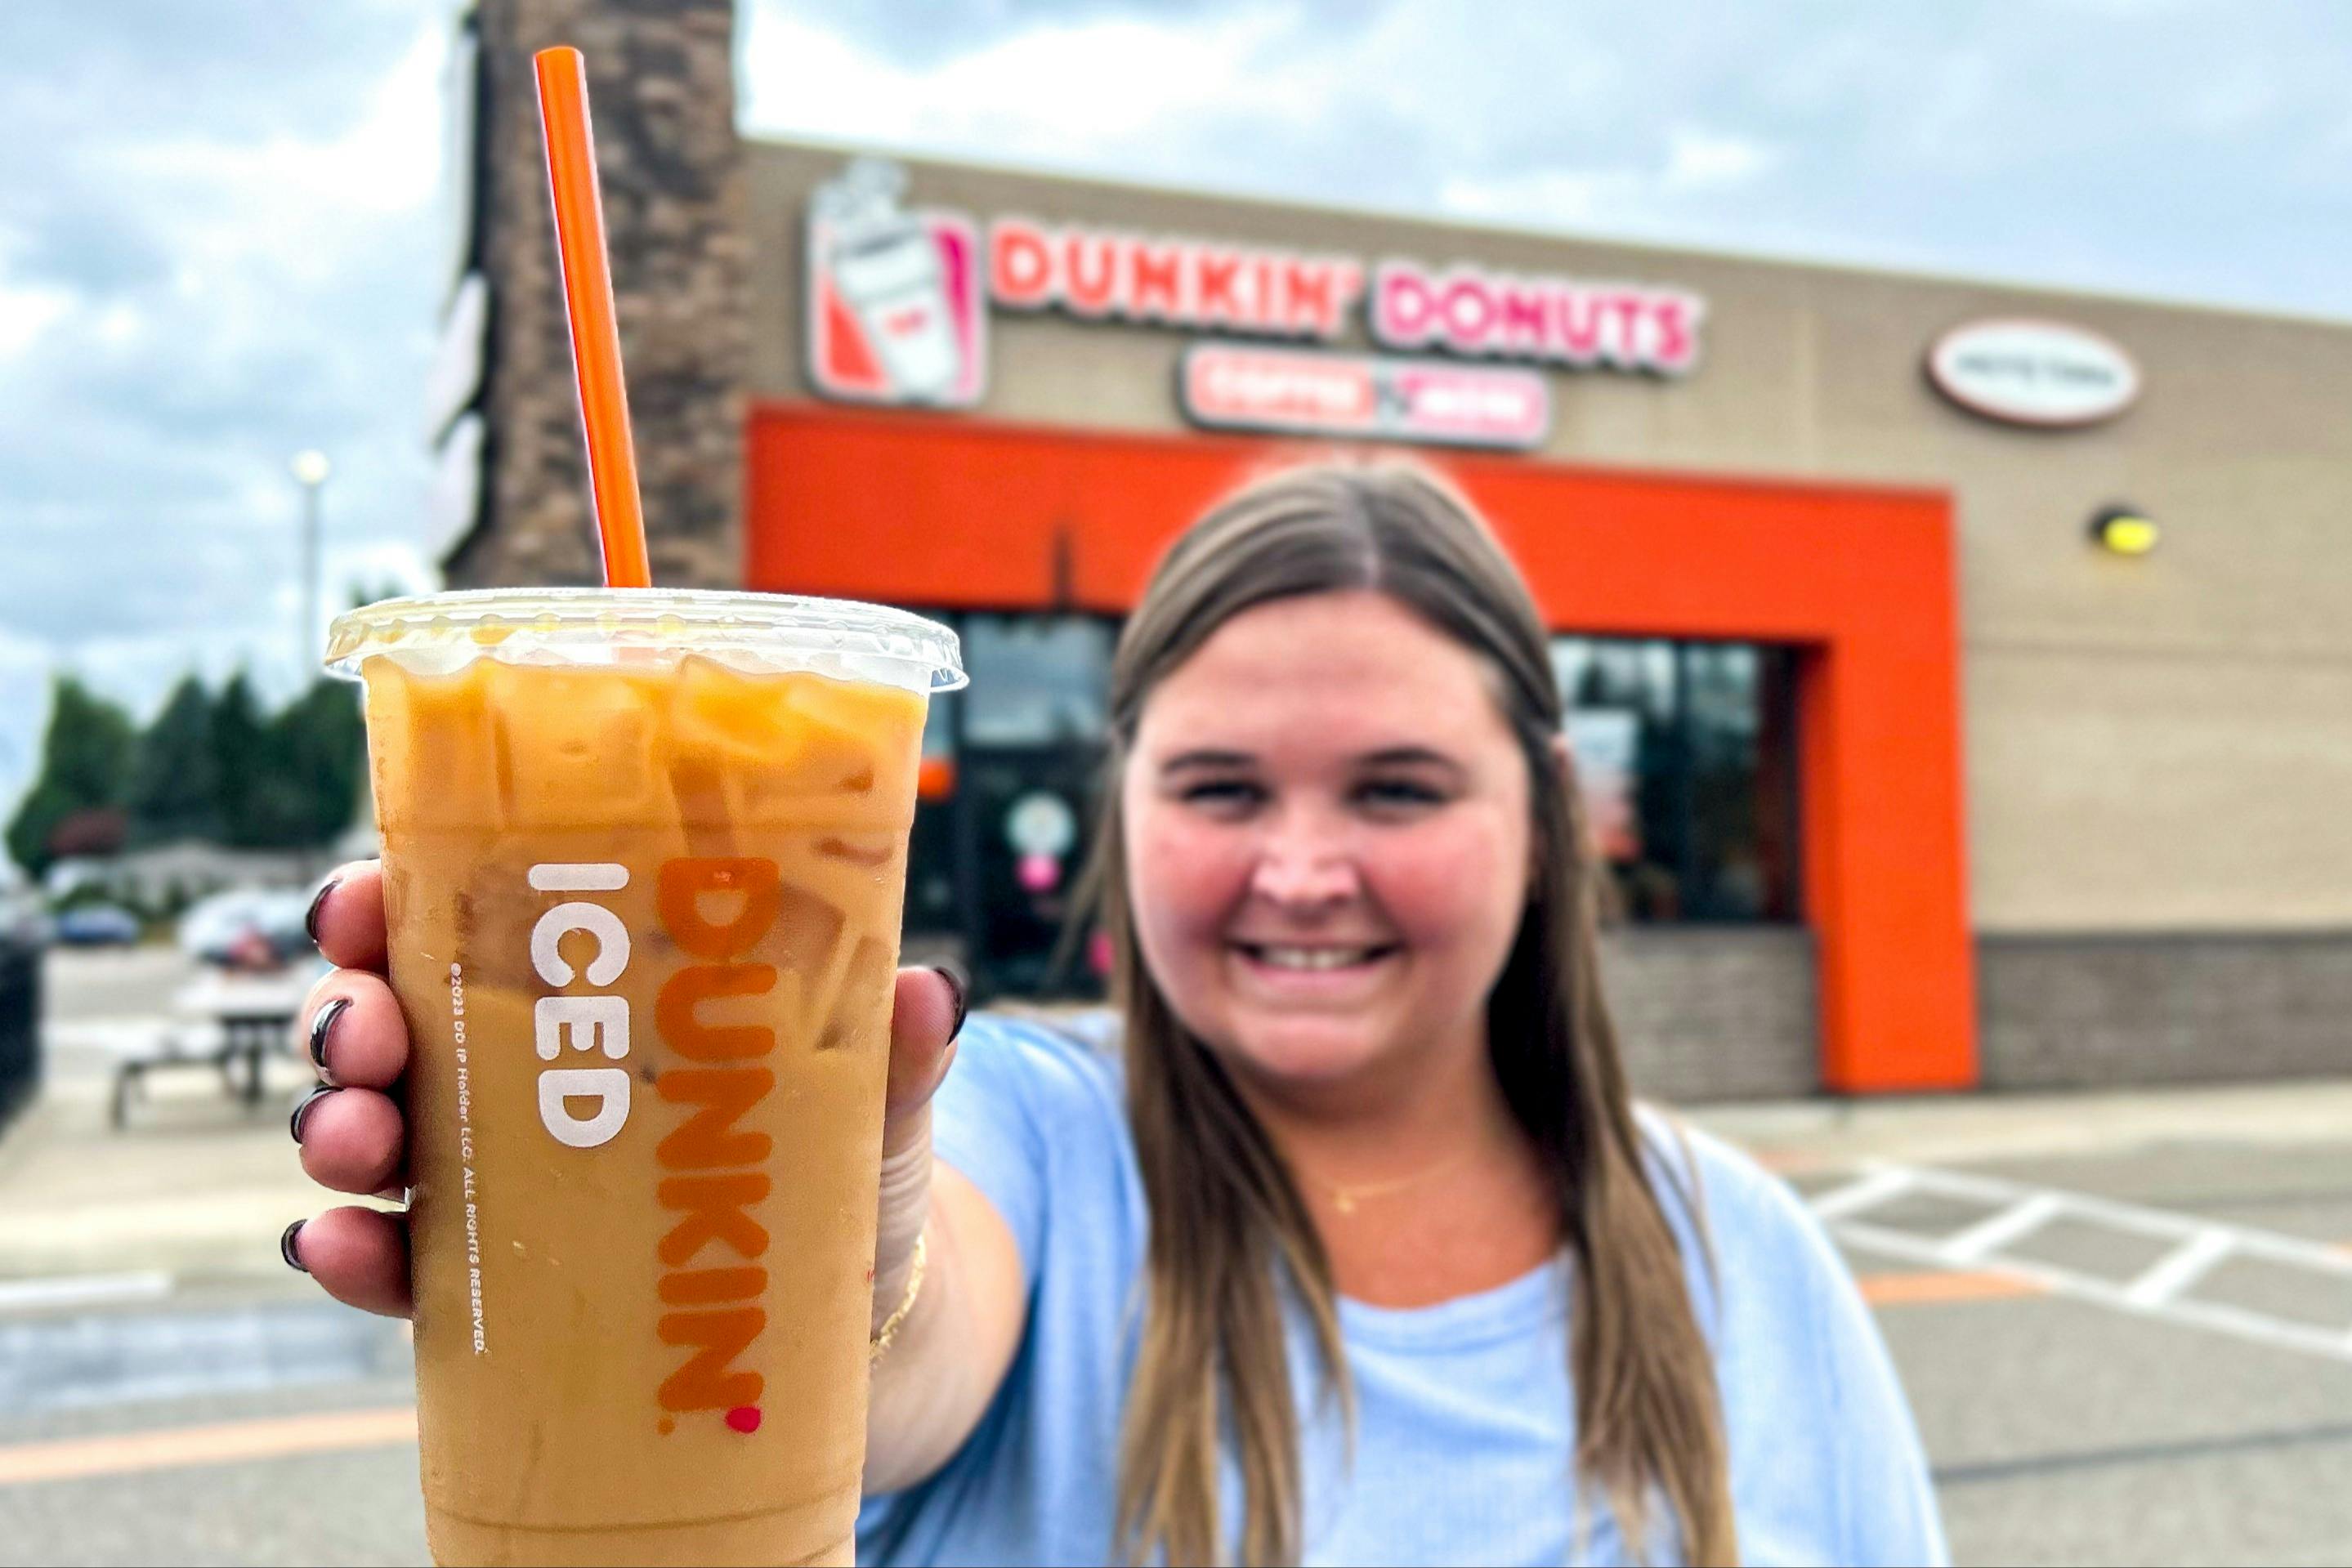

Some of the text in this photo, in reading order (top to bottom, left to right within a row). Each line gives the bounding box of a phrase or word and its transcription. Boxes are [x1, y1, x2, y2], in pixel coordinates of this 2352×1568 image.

[991, 223, 1692, 363] DUNKIN' DONUTS
[527, 862, 631, 1148] ICED
[456, 1048, 467, 1063] IP
[458, 1067, 470, 1123] Holder
[655, 856, 780, 1434] DUNKIN'
[463, 1167, 476, 1199] ALL
[466, 1203, 480, 1264] RIGHTS
